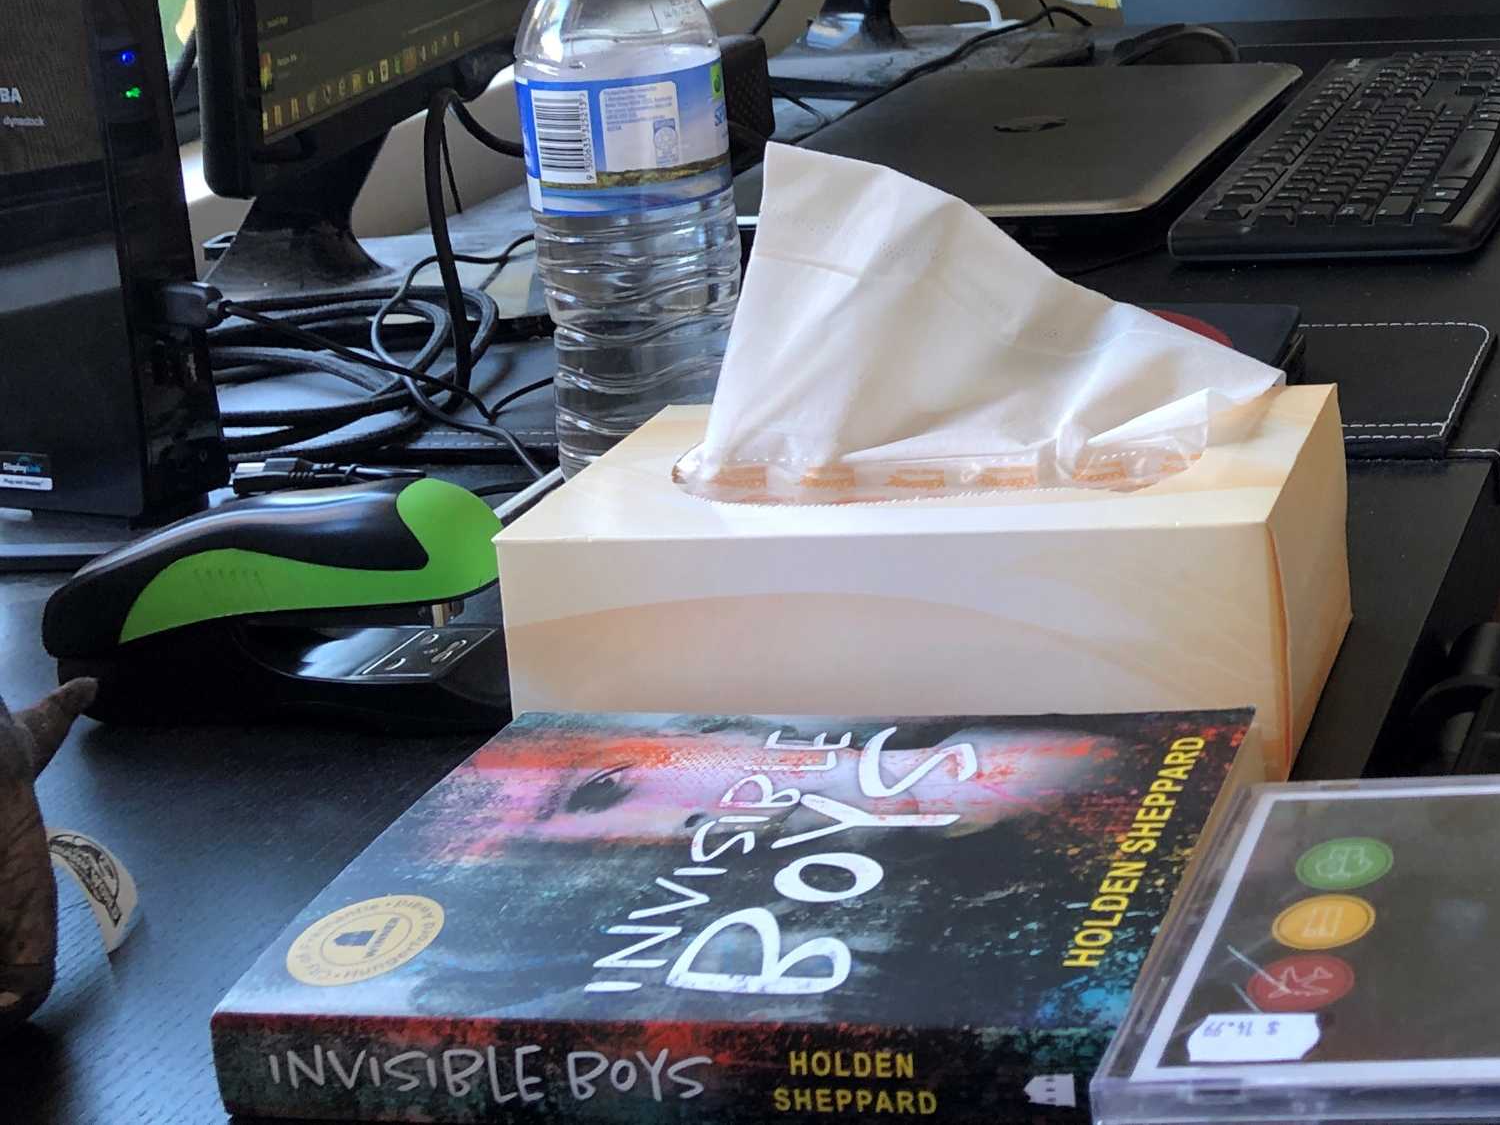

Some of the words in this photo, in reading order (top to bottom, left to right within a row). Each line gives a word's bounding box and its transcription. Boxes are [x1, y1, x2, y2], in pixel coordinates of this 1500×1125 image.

[584, 730, 852, 993] INVISIBLE
[665, 726, 978, 995] BOYS
[1063, 860, 1147, 967] HOLDEN
[1120, 736, 1205, 854] SHEPPARD
[269, 1045, 545, 1103] INVISIBLE
[566, 1047, 712, 1101] BOYS
[773, 1085, 937, 1115] SHEPPARD
[788, 1050, 914, 1078] HOLDEN
